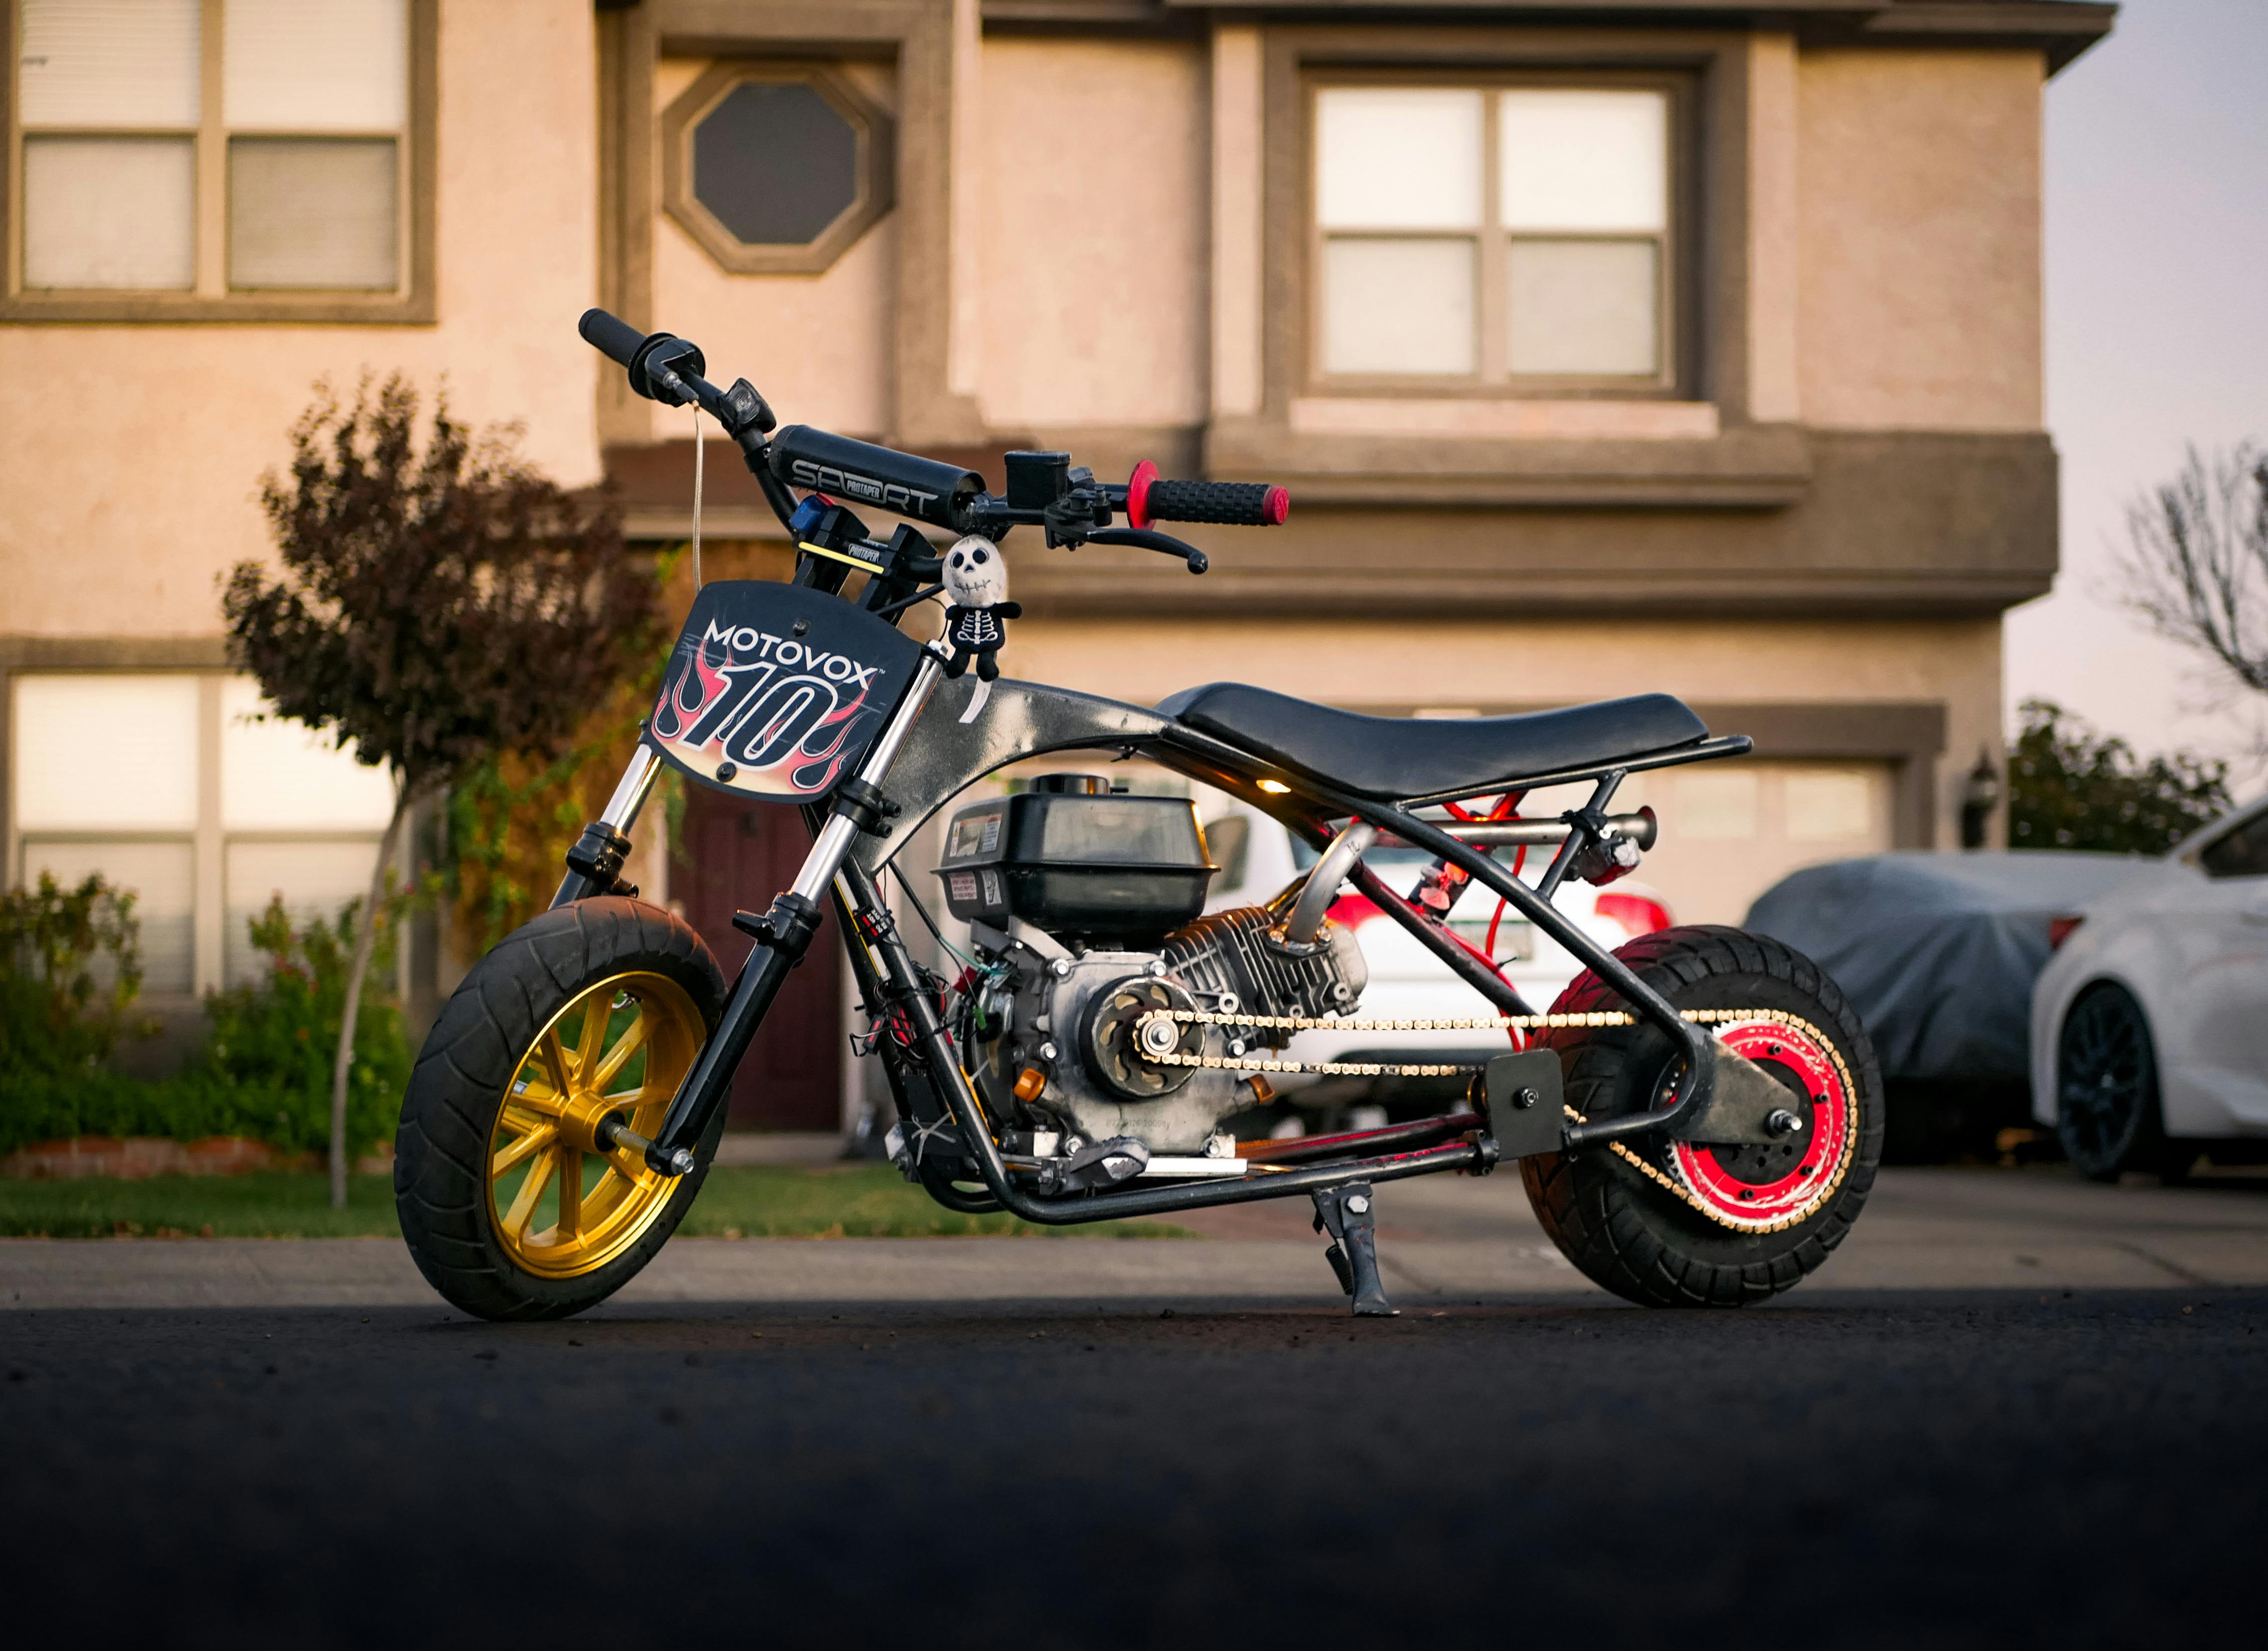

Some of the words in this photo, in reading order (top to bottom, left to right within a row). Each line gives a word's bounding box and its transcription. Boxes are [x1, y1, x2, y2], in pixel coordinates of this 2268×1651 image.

[847, 480, 880, 499] PROTAPER
[848, 544, 880, 564] PROTAPER
[704, 618, 878, 691] MOTOVOX
[677, 661, 838, 772] 10
